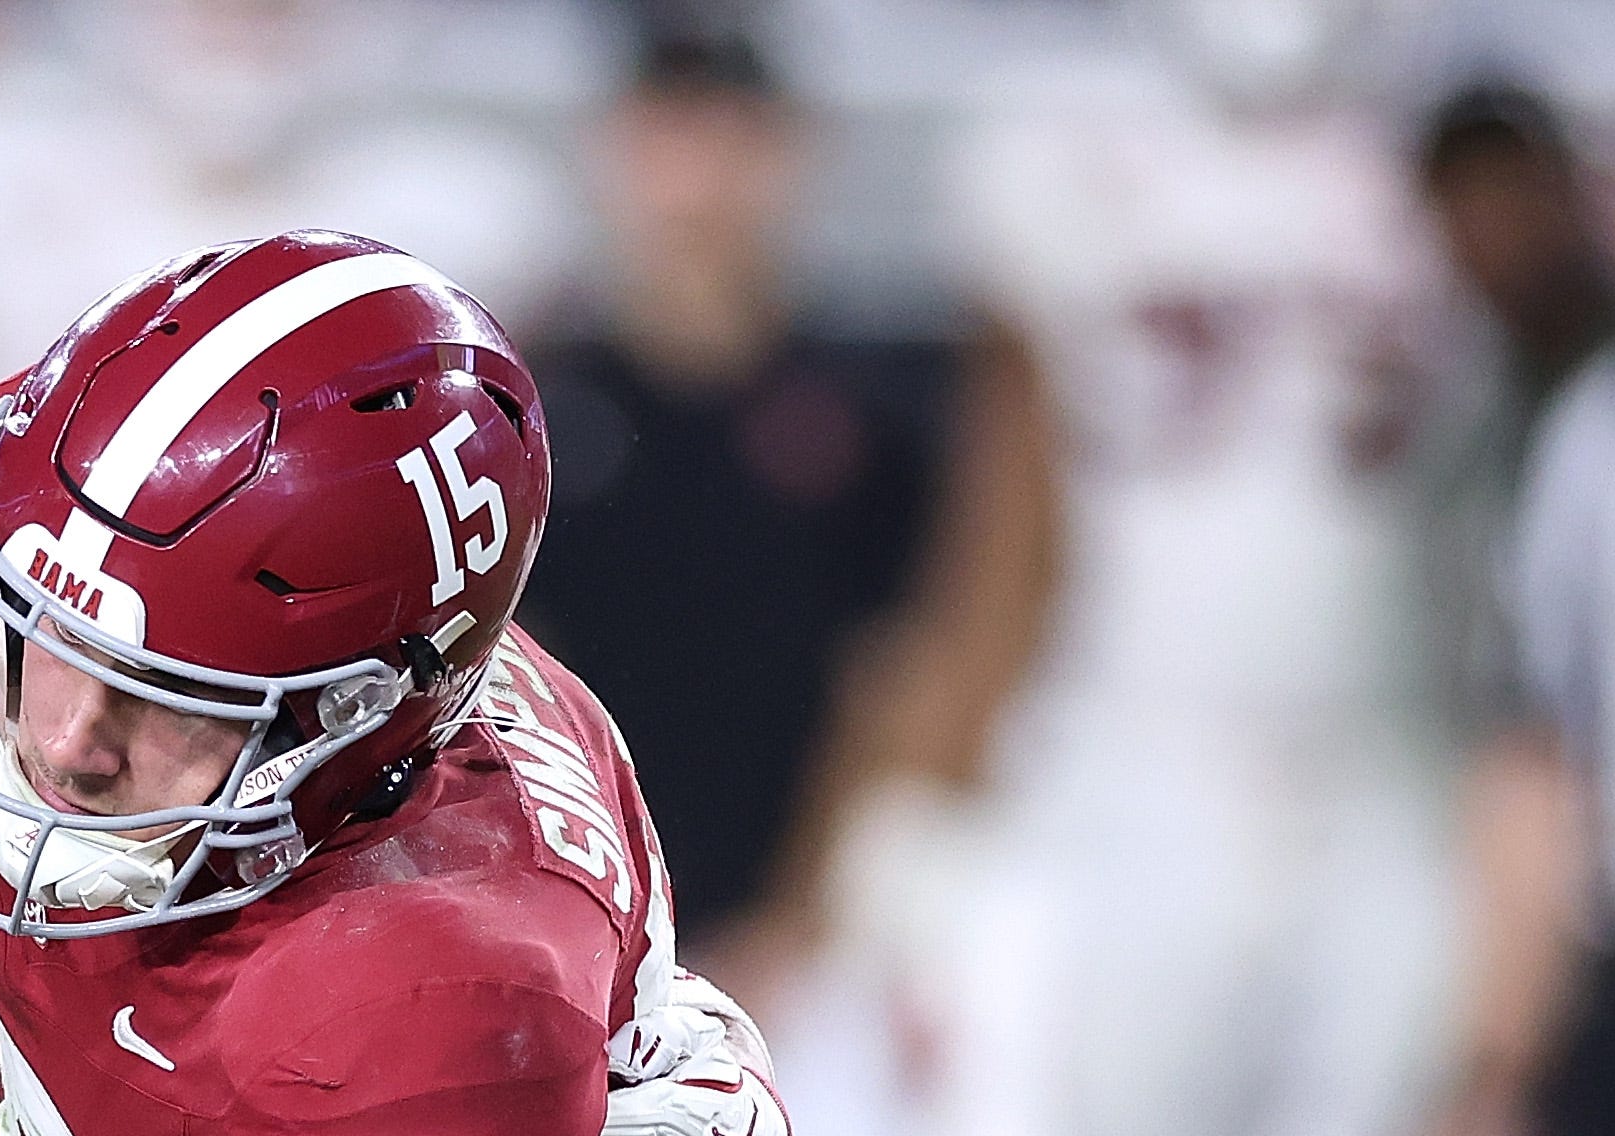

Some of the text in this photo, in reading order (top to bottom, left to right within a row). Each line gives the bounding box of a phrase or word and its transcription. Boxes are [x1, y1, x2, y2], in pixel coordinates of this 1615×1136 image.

[27, 547, 104, 621] BAMA
[395, 410, 509, 607] 15
[480, 631, 632, 914] SIMPS
